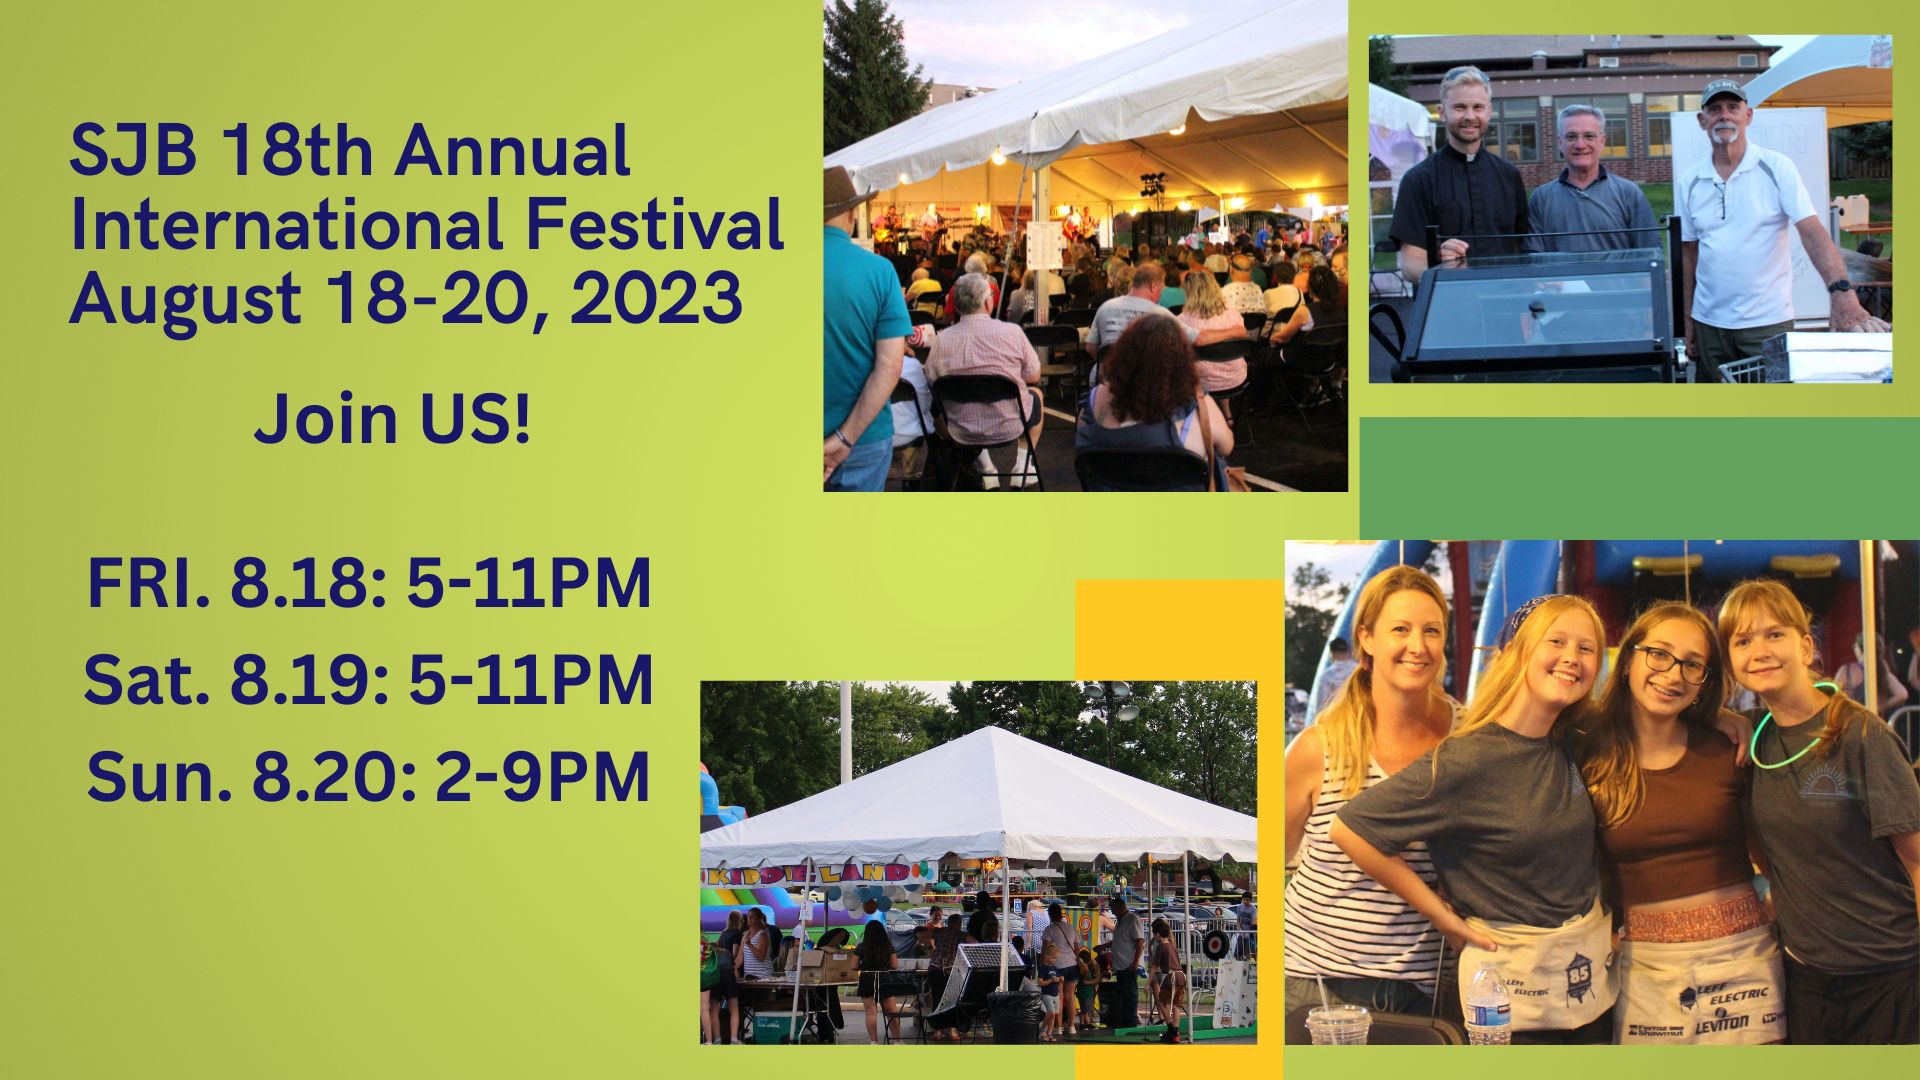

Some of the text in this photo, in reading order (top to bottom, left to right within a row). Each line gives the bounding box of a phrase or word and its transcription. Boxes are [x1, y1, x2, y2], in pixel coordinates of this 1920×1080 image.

[707, 863, 911, 886] KIDDIE LAND
[1569, 966, 1589, 984] 85
[1514, 987, 1549, 997] ELECTRIC
[1697, 982, 1728, 995] LEFF
[1710, 987, 1769, 1005] ELECTRIC
[1695, 1014, 1749, 1035] LEVITON
